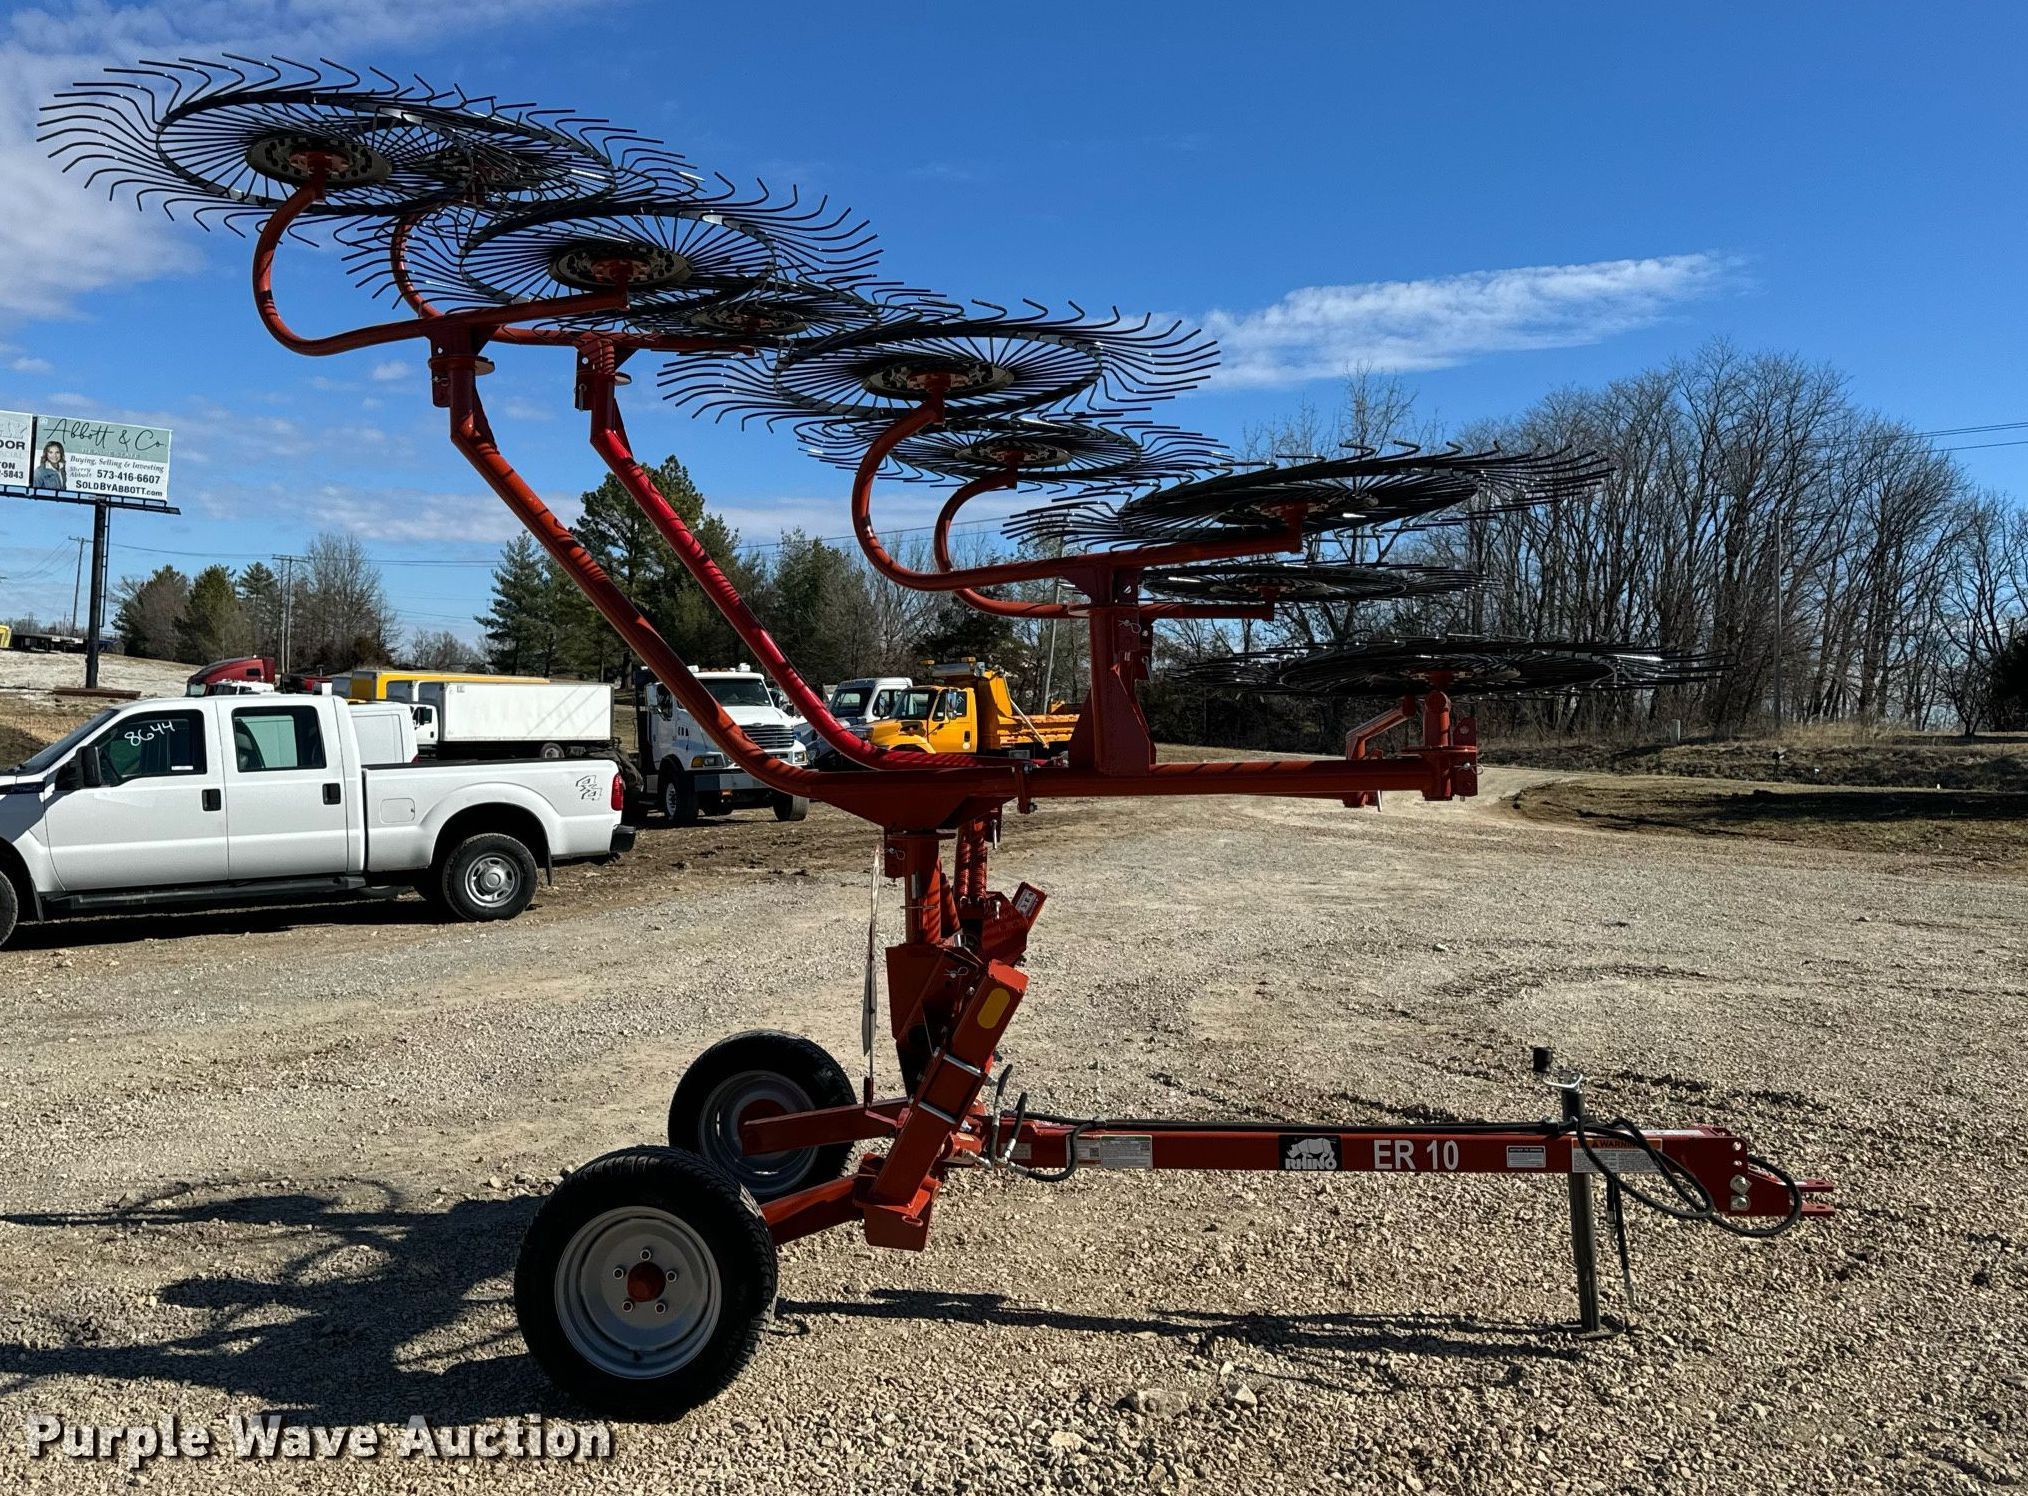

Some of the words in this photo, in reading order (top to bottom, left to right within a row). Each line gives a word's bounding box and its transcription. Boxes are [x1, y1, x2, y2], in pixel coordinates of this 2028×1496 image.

[44, 419, 114, 449] Abbott
[118, 430, 131, 451] &
[135, 429, 166, 450] Co.
[99, 458, 122, 468] Selling
[132, 462, 164, 473] Investing
[0, 470, 24, 479] -5843
[97, 470, 160, 484] 573-416-6607
[124, 720, 176, 747] 8644
[1600, 1140, 1641, 1148] WARNIN
[1373, 1139, 1416, 1170] ER
[1426, 1139, 1459, 1171] 10
